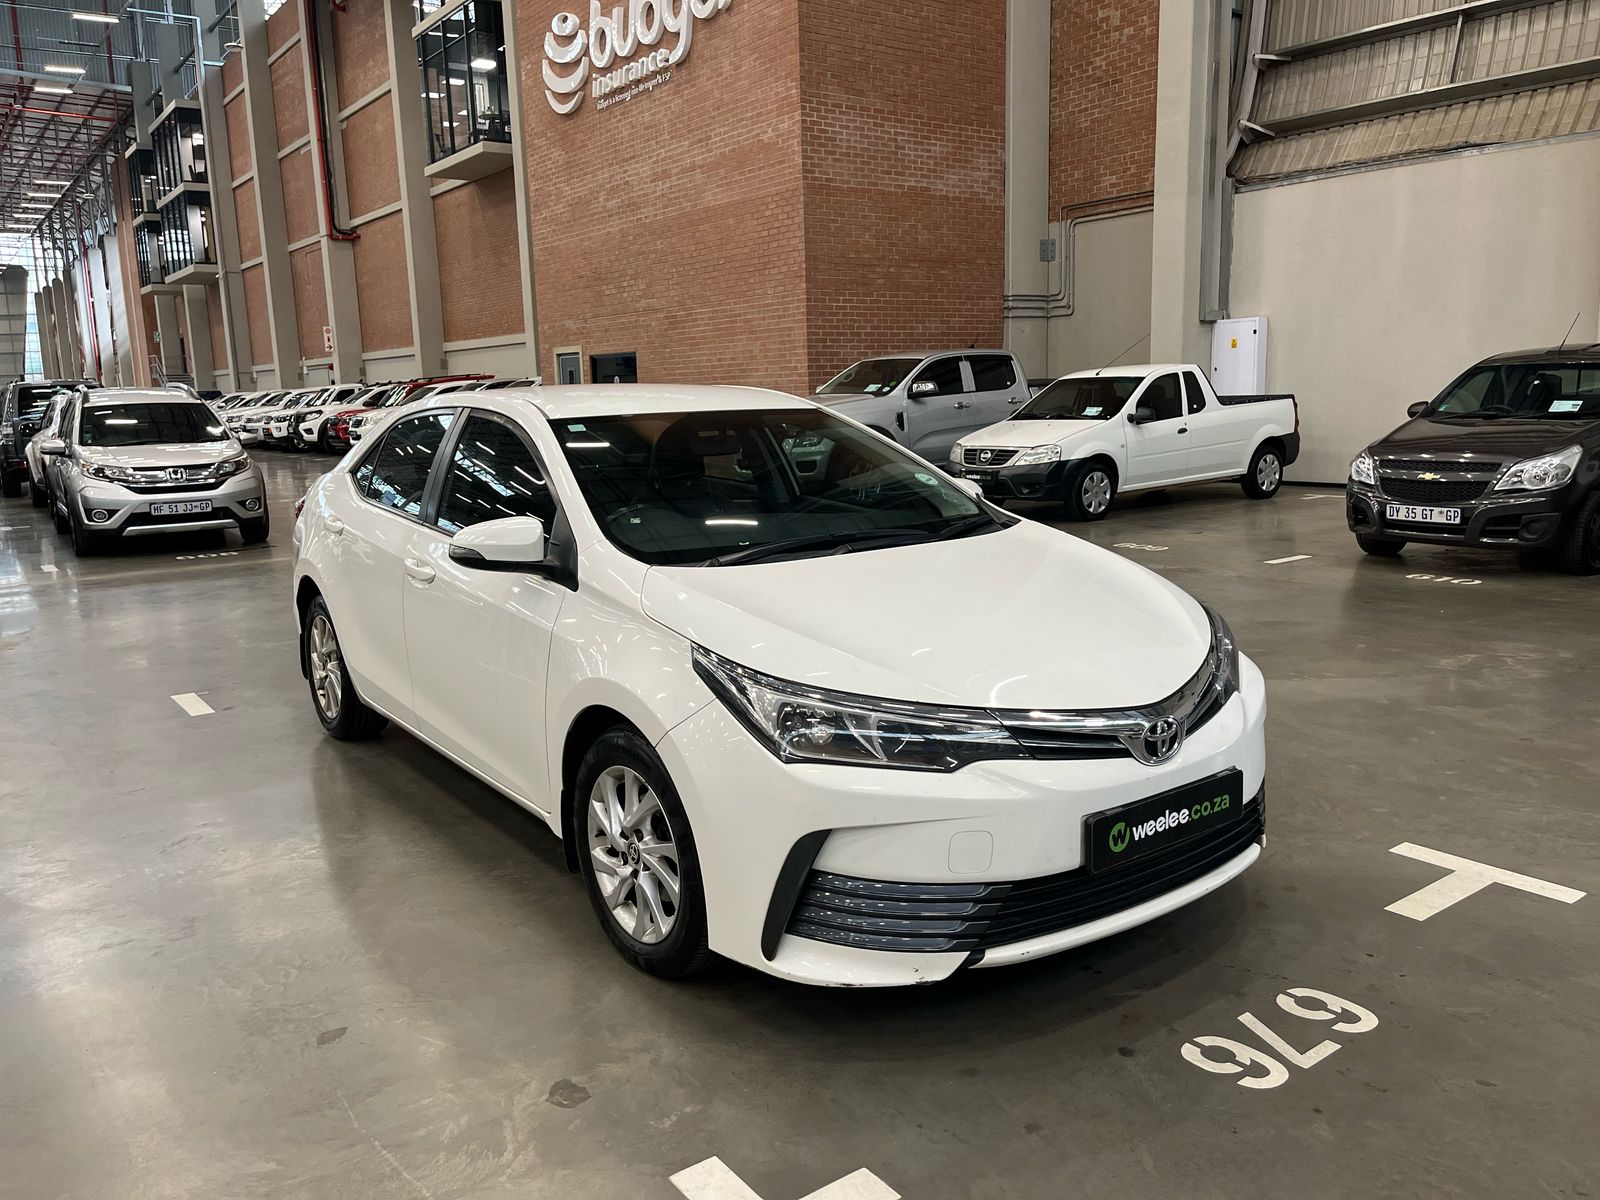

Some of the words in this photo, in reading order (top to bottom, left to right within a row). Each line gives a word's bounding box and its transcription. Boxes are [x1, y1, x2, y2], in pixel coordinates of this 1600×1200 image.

[589, 0, 731, 68] budg
[592, 49, 670, 97] insurance
[153, 505, 164, 514] HF
[169, 504, 179, 513] 51
[183, 503, 193, 512] JJ
[200, 502, 210, 511] GP
[1389, 505, 1400, 517] DY
[1405, 507, 1417, 519] 35
[1421, 508, 1434, 520] GT
[1445, 510, 1459, 521] GP
[1132, 794, 1230, 841] weelee.co.za
[1180, 987, 1379, 1090] 676
